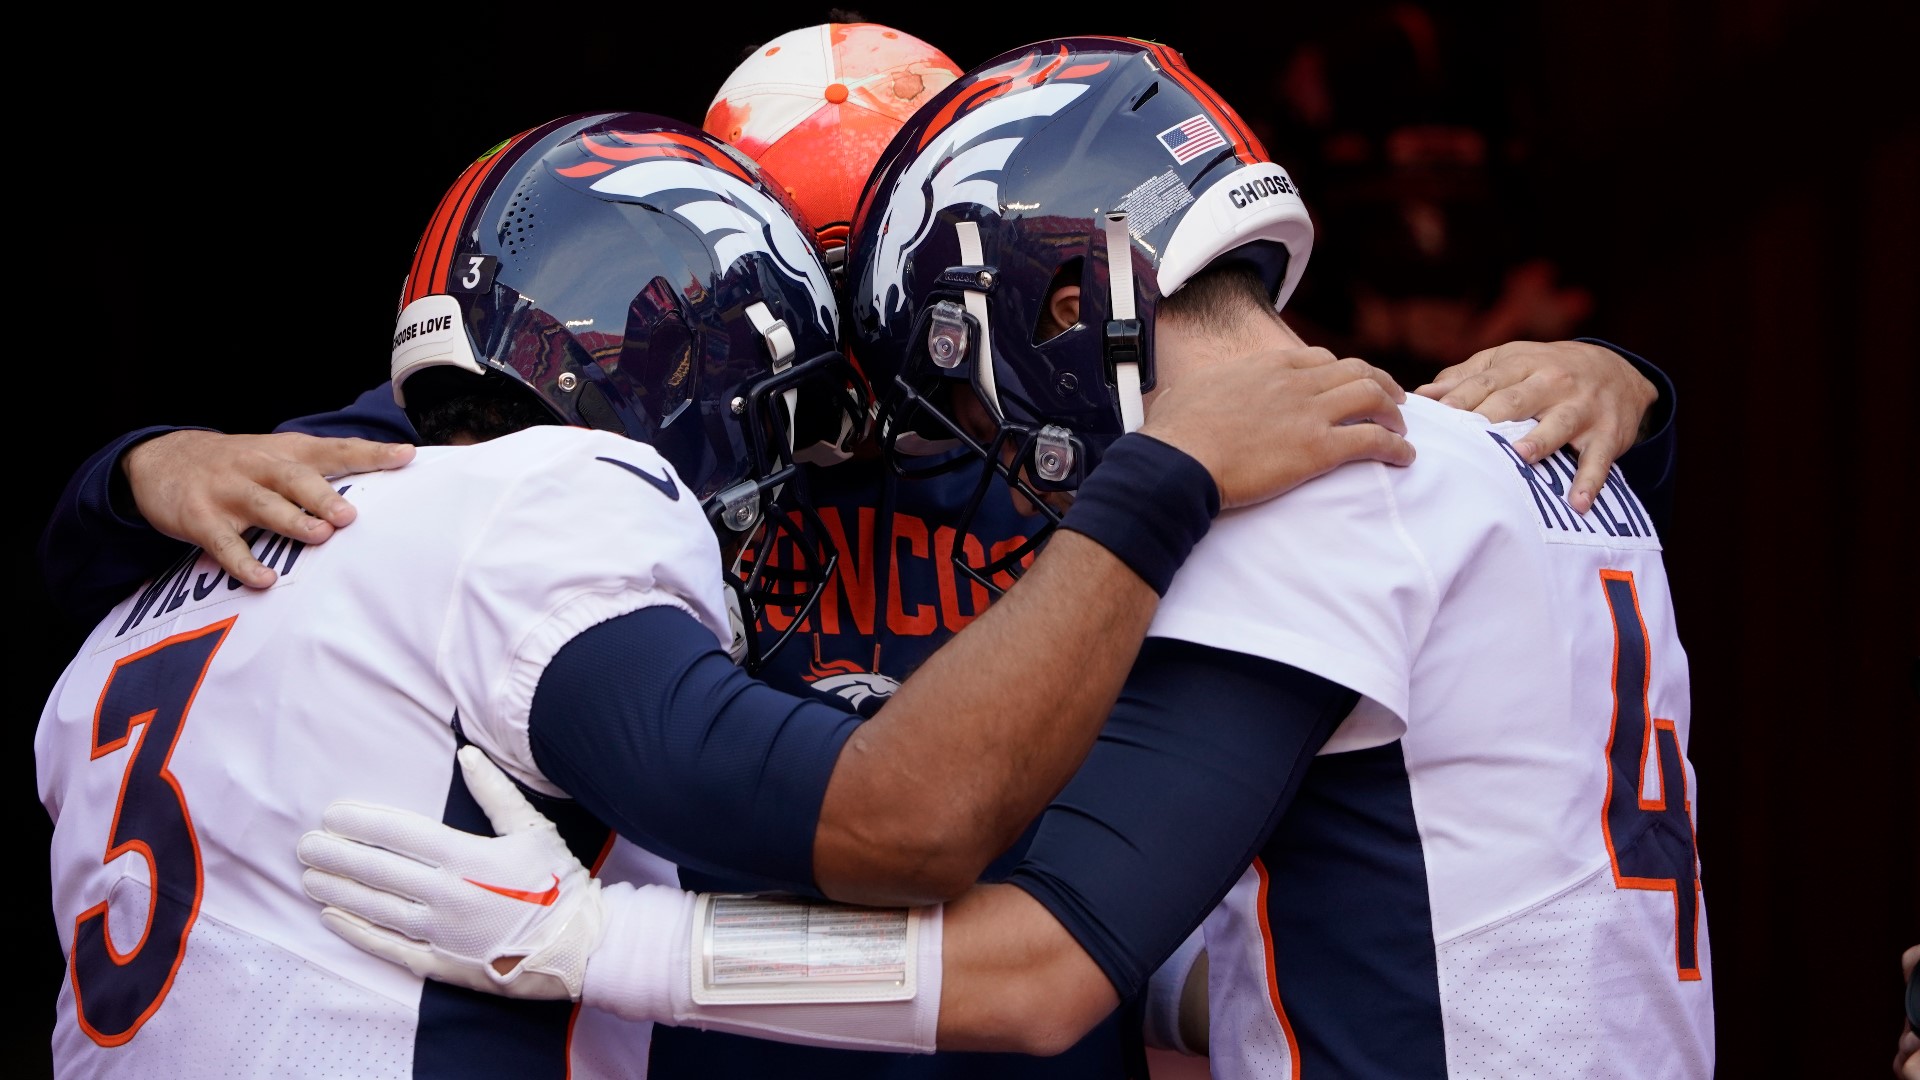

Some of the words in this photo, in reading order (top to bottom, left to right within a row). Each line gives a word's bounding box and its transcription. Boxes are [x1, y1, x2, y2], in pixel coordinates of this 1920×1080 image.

[1228, 175, 1294, 209] CHOOSE
[462, 256, 485, 289] 3
[392, 323, 418, 351] HOOSE
[420, 315, 452, 336] LOVE
[738, 506, 1035, 636] ONCO
[1599, 568, 1702, 981] 4
[71, 613, 239, 1048] 3
